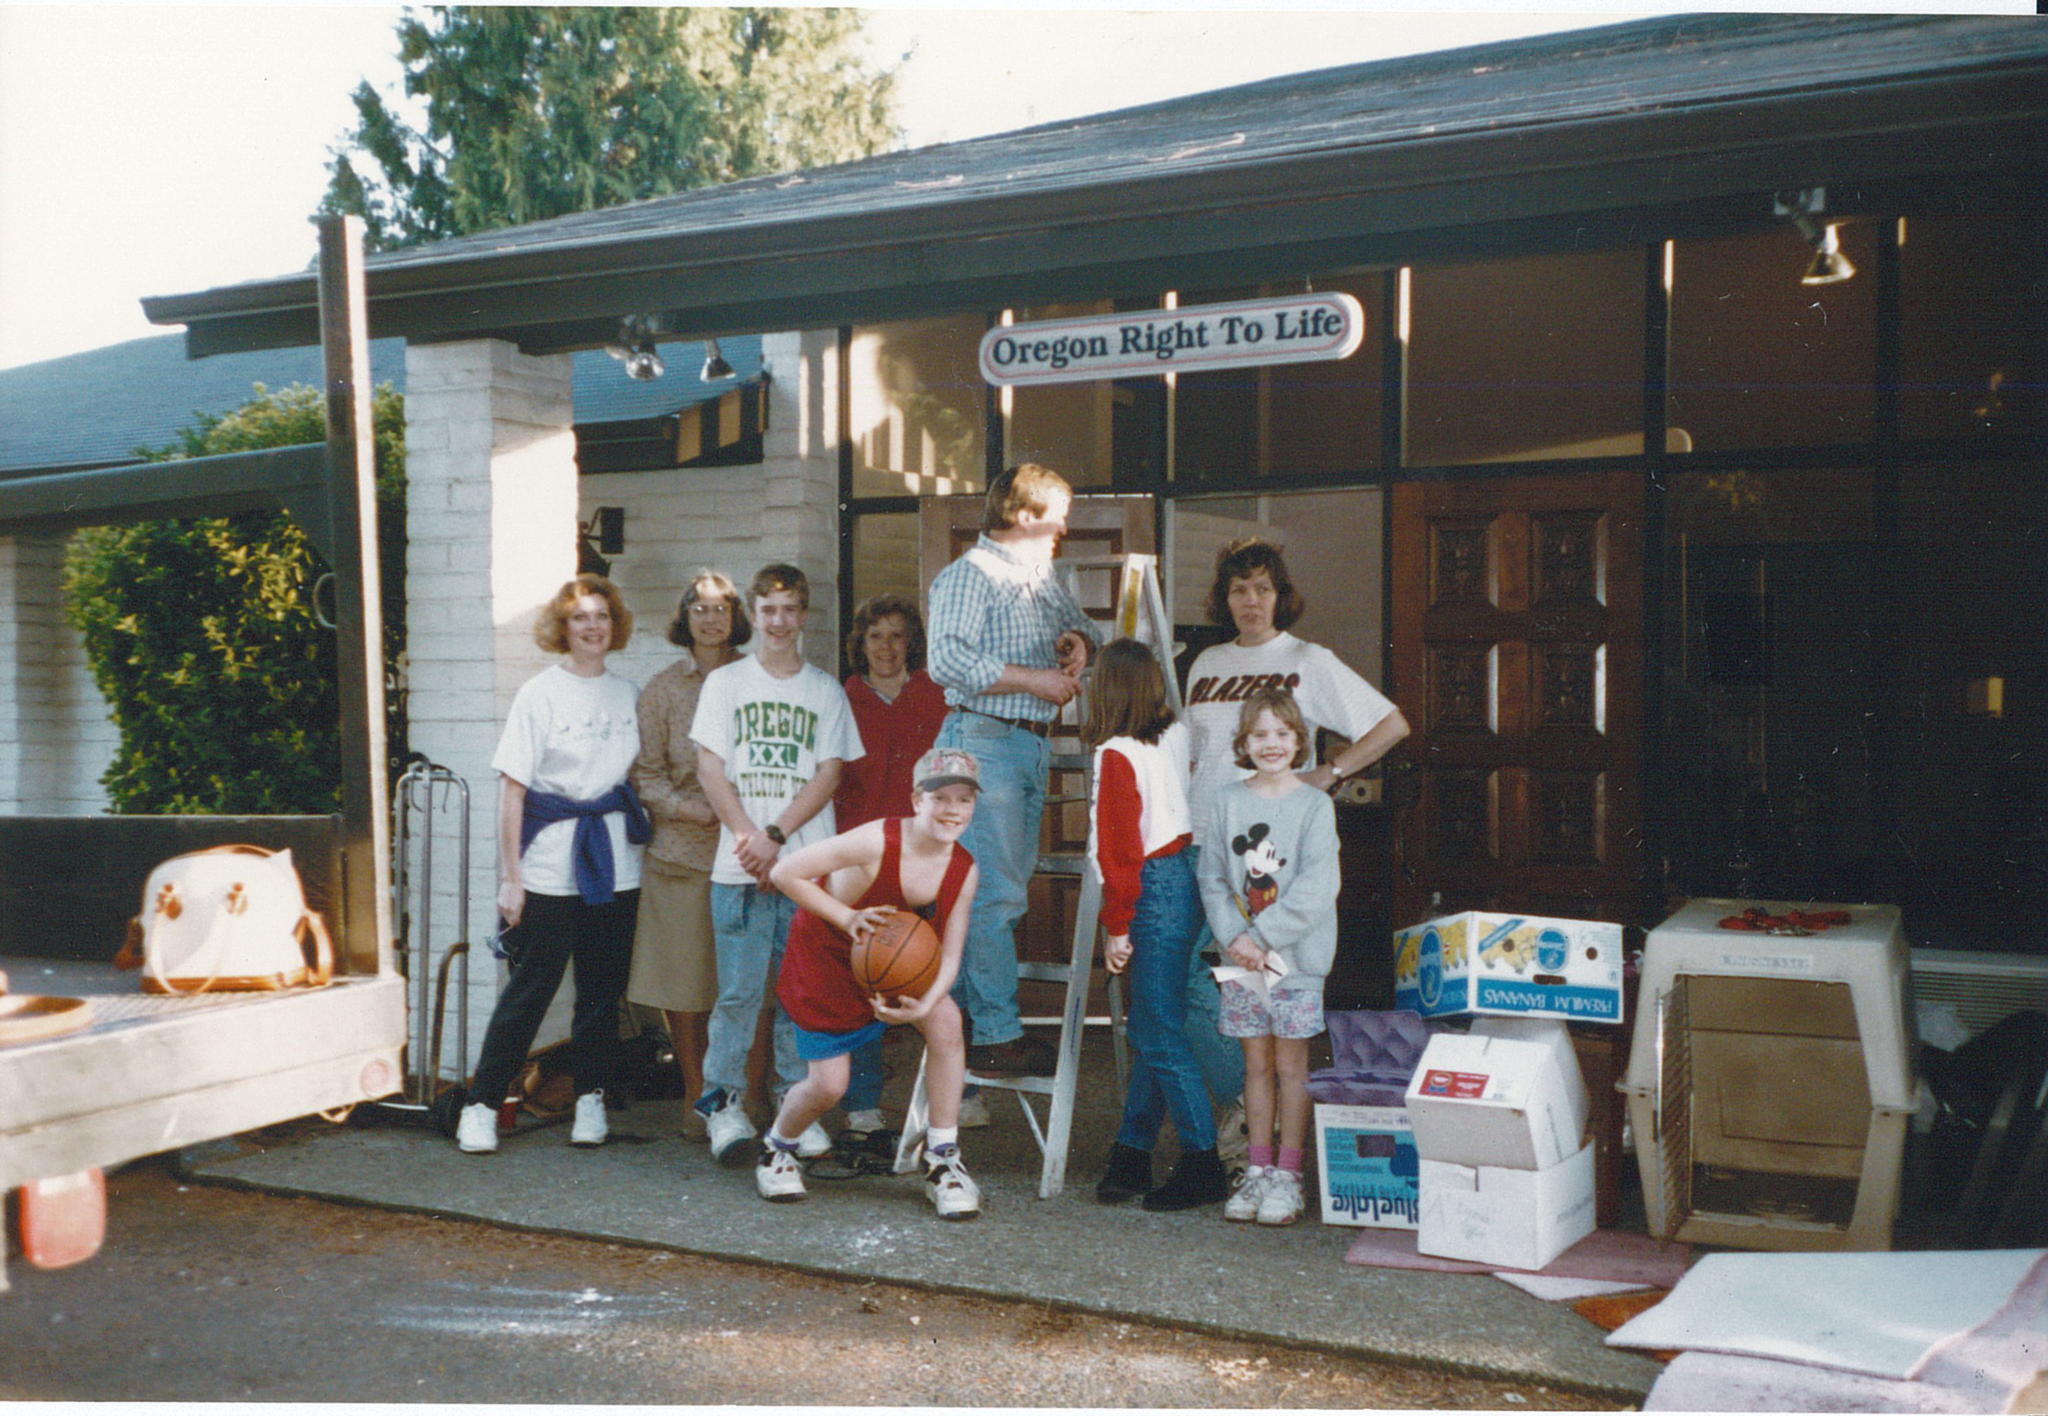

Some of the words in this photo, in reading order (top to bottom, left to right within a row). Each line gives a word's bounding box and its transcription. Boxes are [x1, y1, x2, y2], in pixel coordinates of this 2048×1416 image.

[993, 334, 1108, 368] Oregon
[1120, 319, 1208, 360] Right
[1219, 316, 1263, 345] To
[1275, 307, 1343, 340] Life
[1189, 672, 1301, 706] BLAZERS
[750, 742, 797, 769] XXL
[1484, 988, 1546, 1009] BANANAS
[1554, 995, 1613, 1014] PREMIUM
